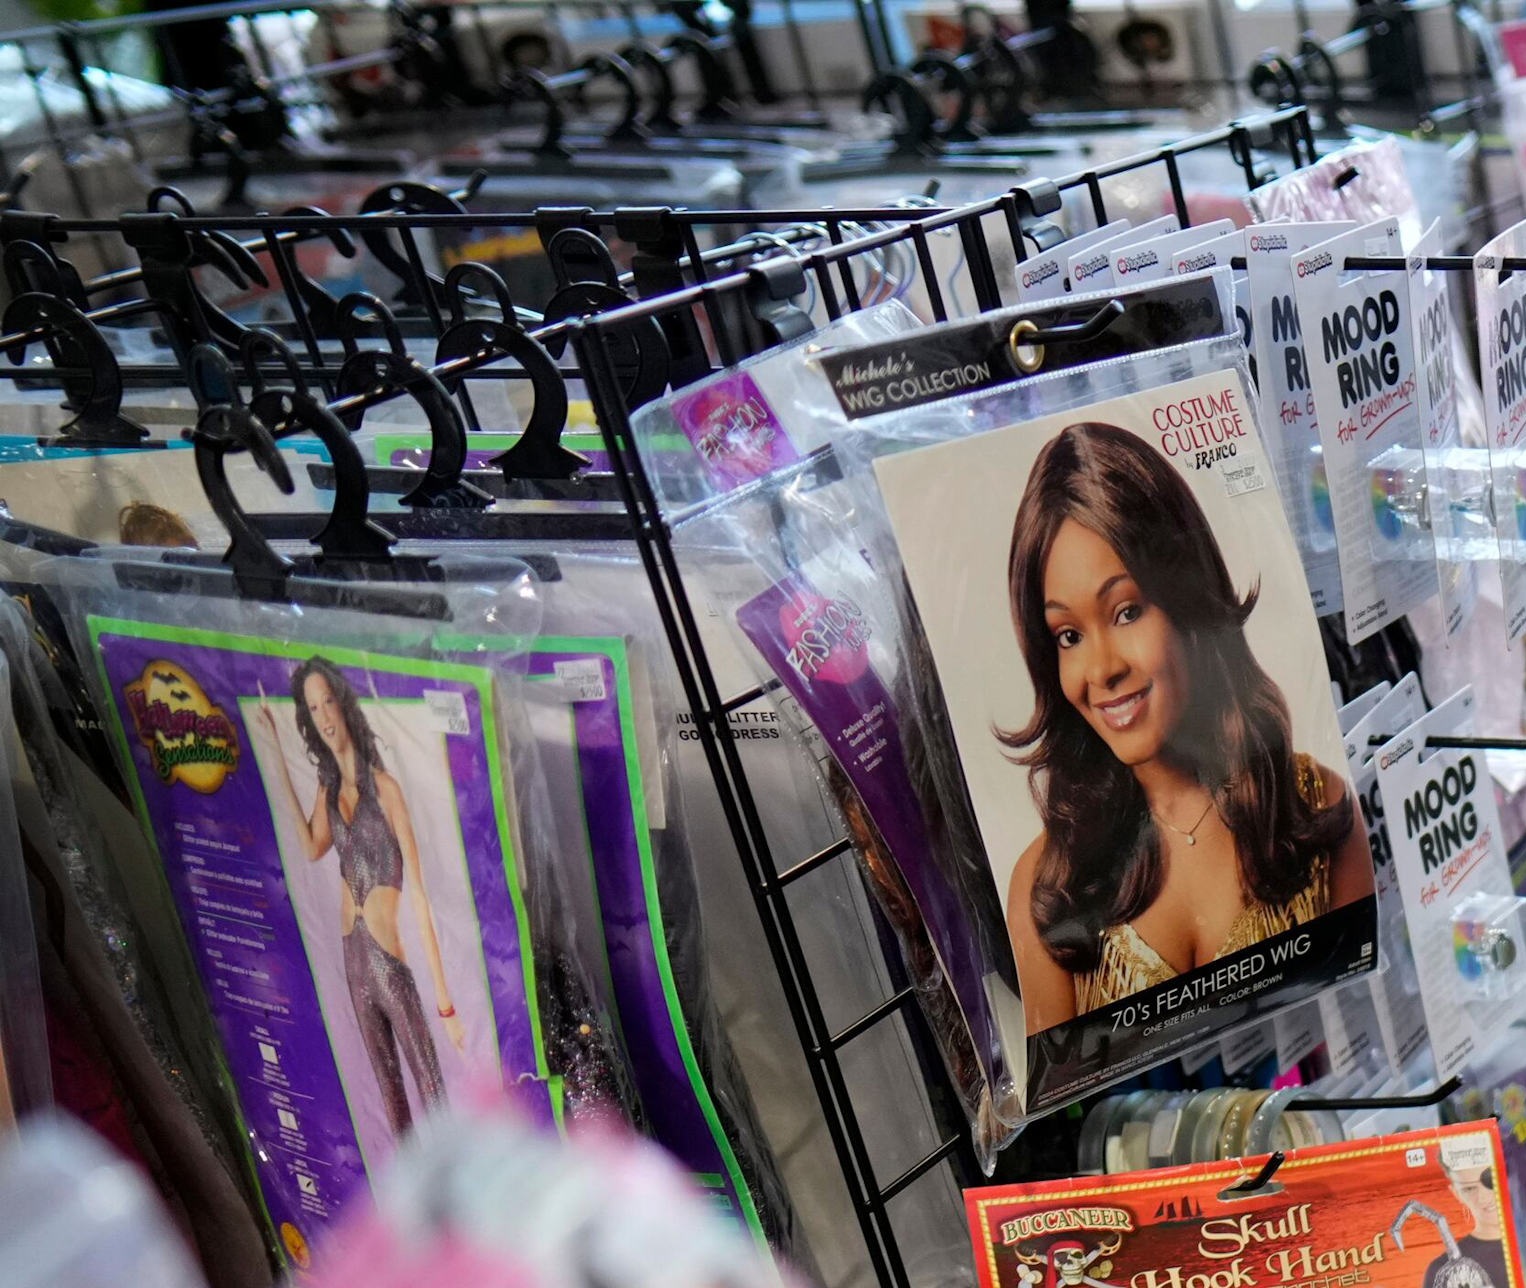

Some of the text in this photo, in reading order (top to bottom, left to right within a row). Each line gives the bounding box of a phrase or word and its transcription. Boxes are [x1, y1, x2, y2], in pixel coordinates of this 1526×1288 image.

[1321, 290, 1399, 364] MOOD
[836, 352, 914, 388] Michele's
[842, 361, 991, 411] WIG COLLECTION
[1337, 341, 1399, 409] RING
[1153, 389, 1238, 431] COSTUME
[1162, 414, 1246, 456] CULTURE
[1195, 443, 1237, 470] FRANCO
[786, 591, 862, 683] FASHION
[724, 711, 780, 725] LITTER
[733, 728, 779, 740] DRESS
[1403, 756, 1476, 840] MOOD
[1419, 802, 1478, 874] RING
[1112, 933, 1311, 1032] 70's FEATHERED WIG
[1143, 973, 1283, 1037] ONE SIZE FITS ALL COLOR: BROWN
[1406, 1153, 1425, 1164] 14+
[1002, 1207, 1134, 1244] BUCCANEER
[1198, 1204, 1312, 1260] Skull
[1266, 1233, 1385, 1280] Hand
